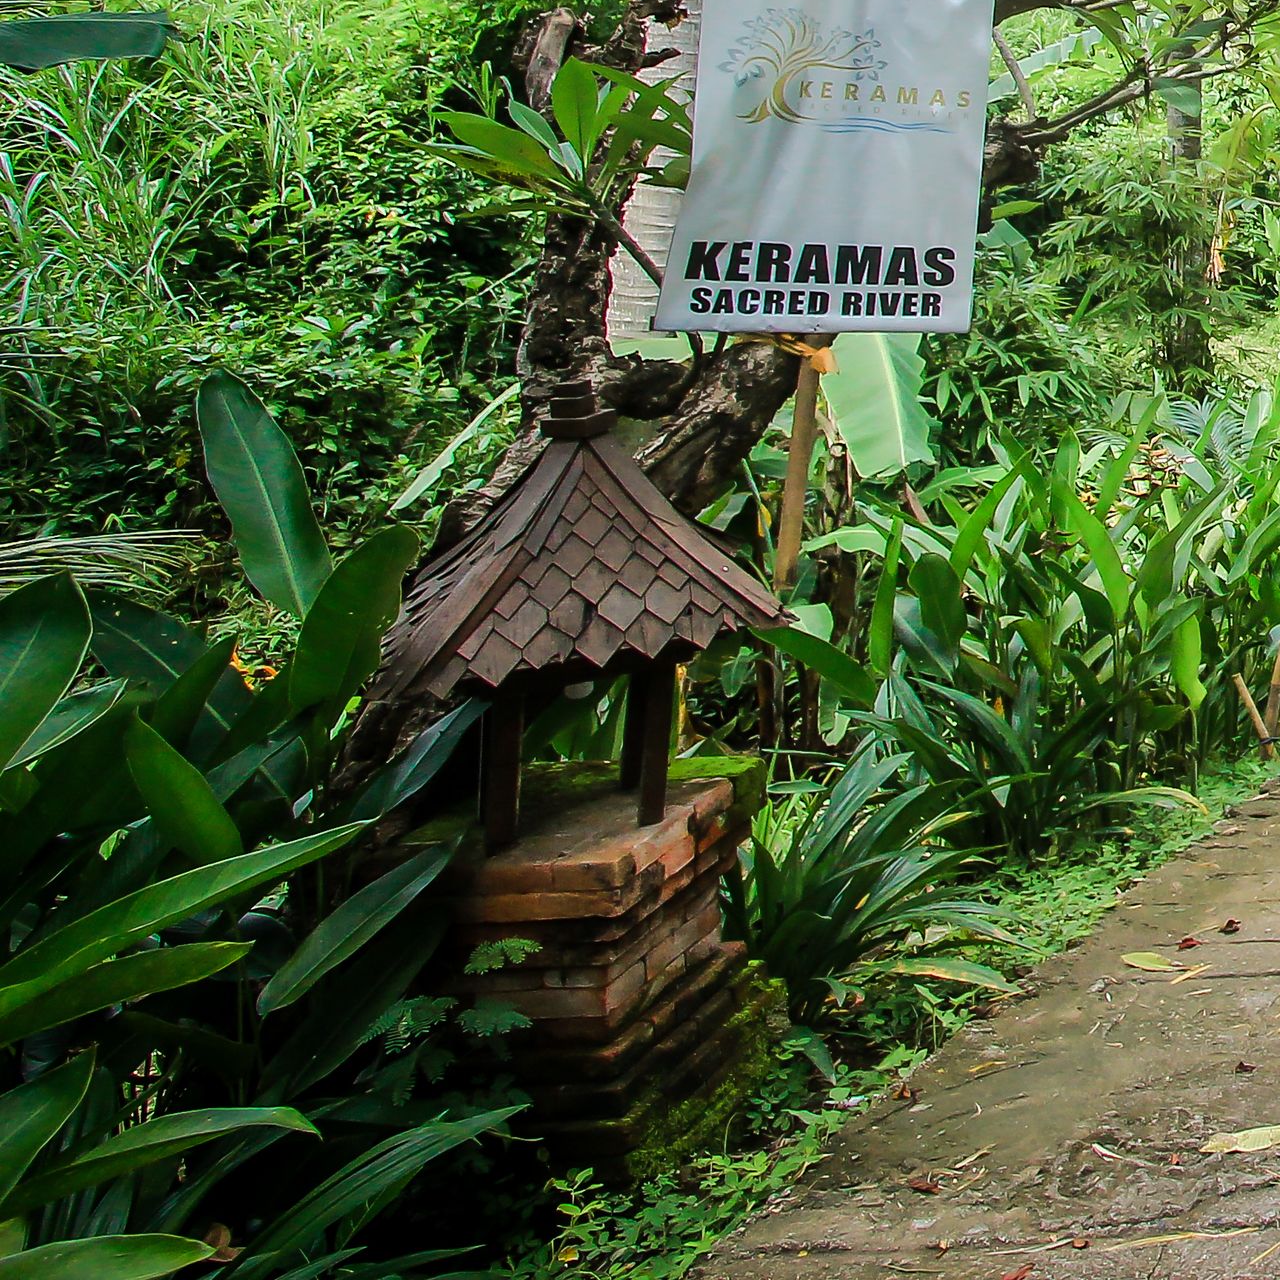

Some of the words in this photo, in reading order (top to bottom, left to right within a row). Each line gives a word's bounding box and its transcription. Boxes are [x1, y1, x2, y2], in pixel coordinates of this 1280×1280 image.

[799, 81, 971, 107] KERAMAS
[684, 240, 956, 287] KERAMAS
[690, 287, 830, 315] SACRED
[841, 292, 942, 317] RIVER
